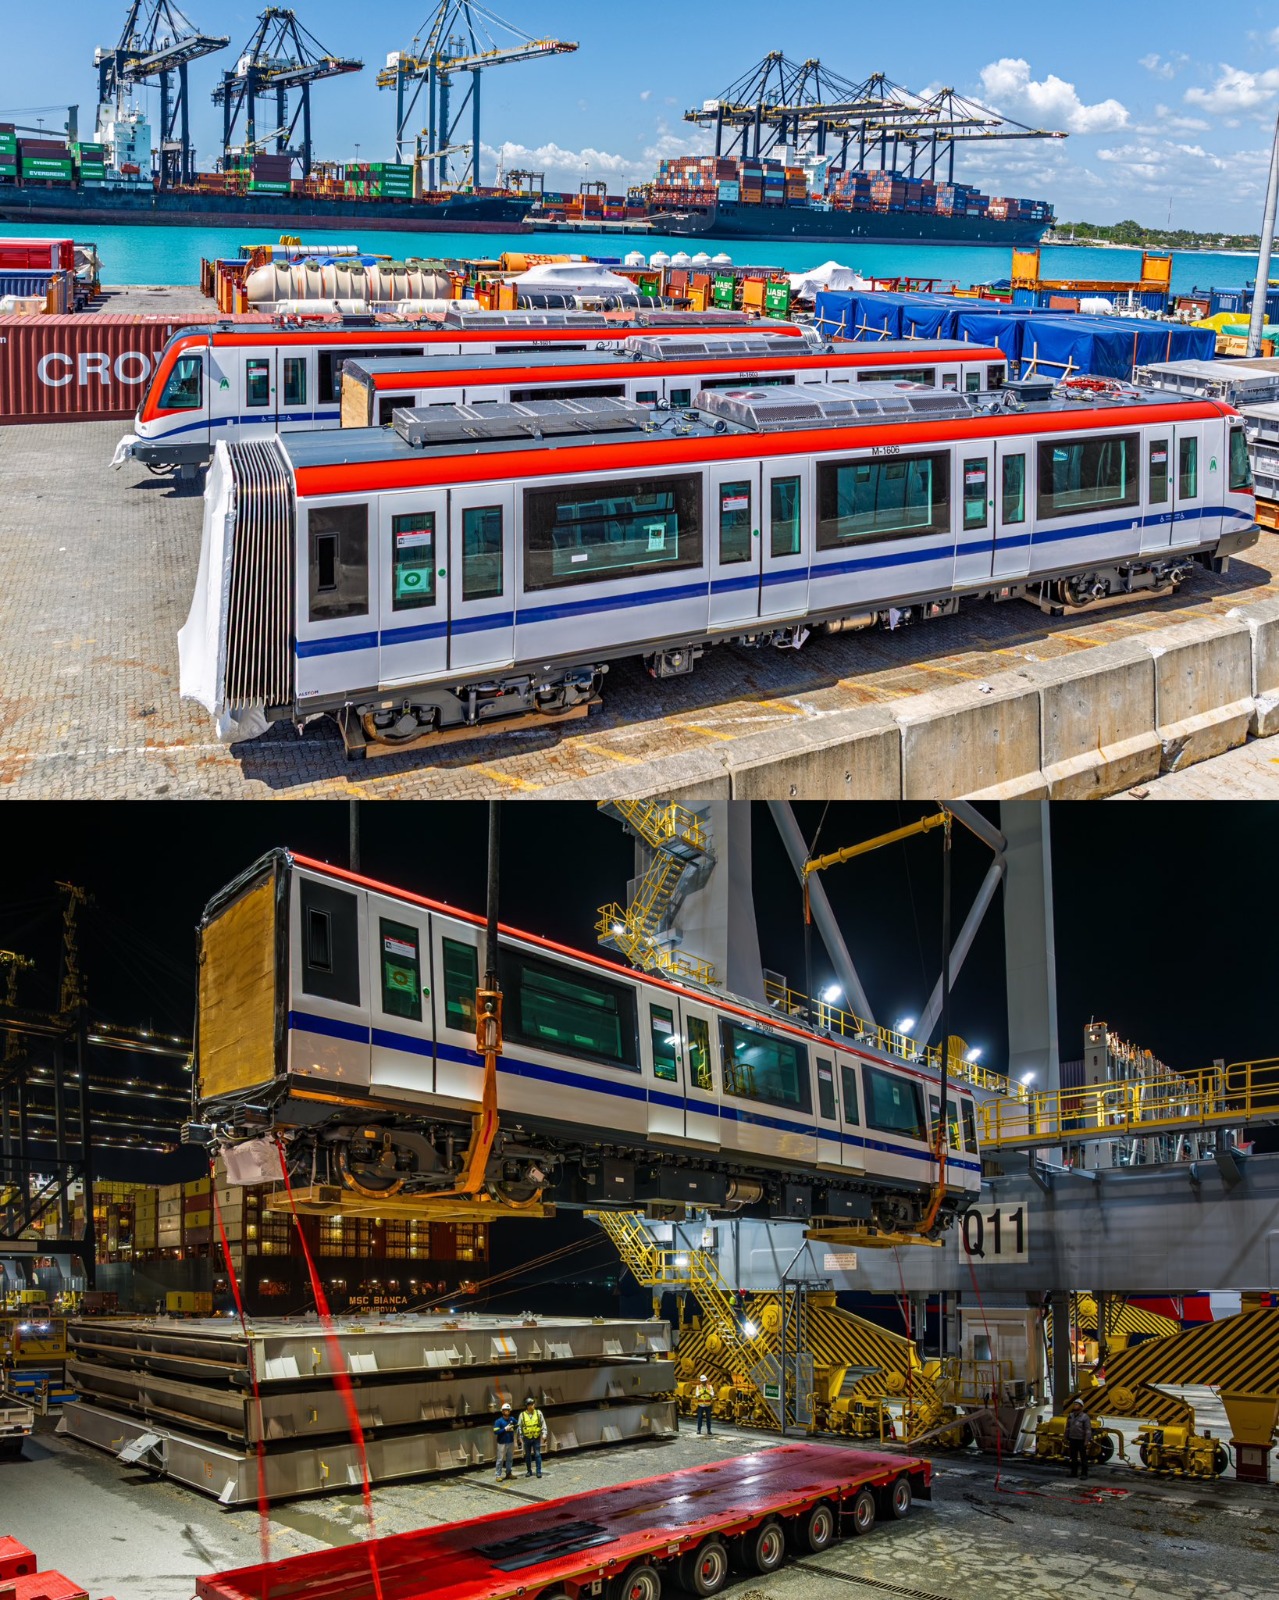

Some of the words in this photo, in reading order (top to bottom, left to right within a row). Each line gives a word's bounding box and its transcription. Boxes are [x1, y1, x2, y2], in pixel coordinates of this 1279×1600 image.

[715, 280, 733, 289] UASC
[767, 288, 787, 297] UASC
[37, 351, 164, 387] CRO
[962, 1206, 1024, 1259] Q11
[349, 1296, 369, 1305] MSC
[373, 1296, 408, 1305] BIANCA
